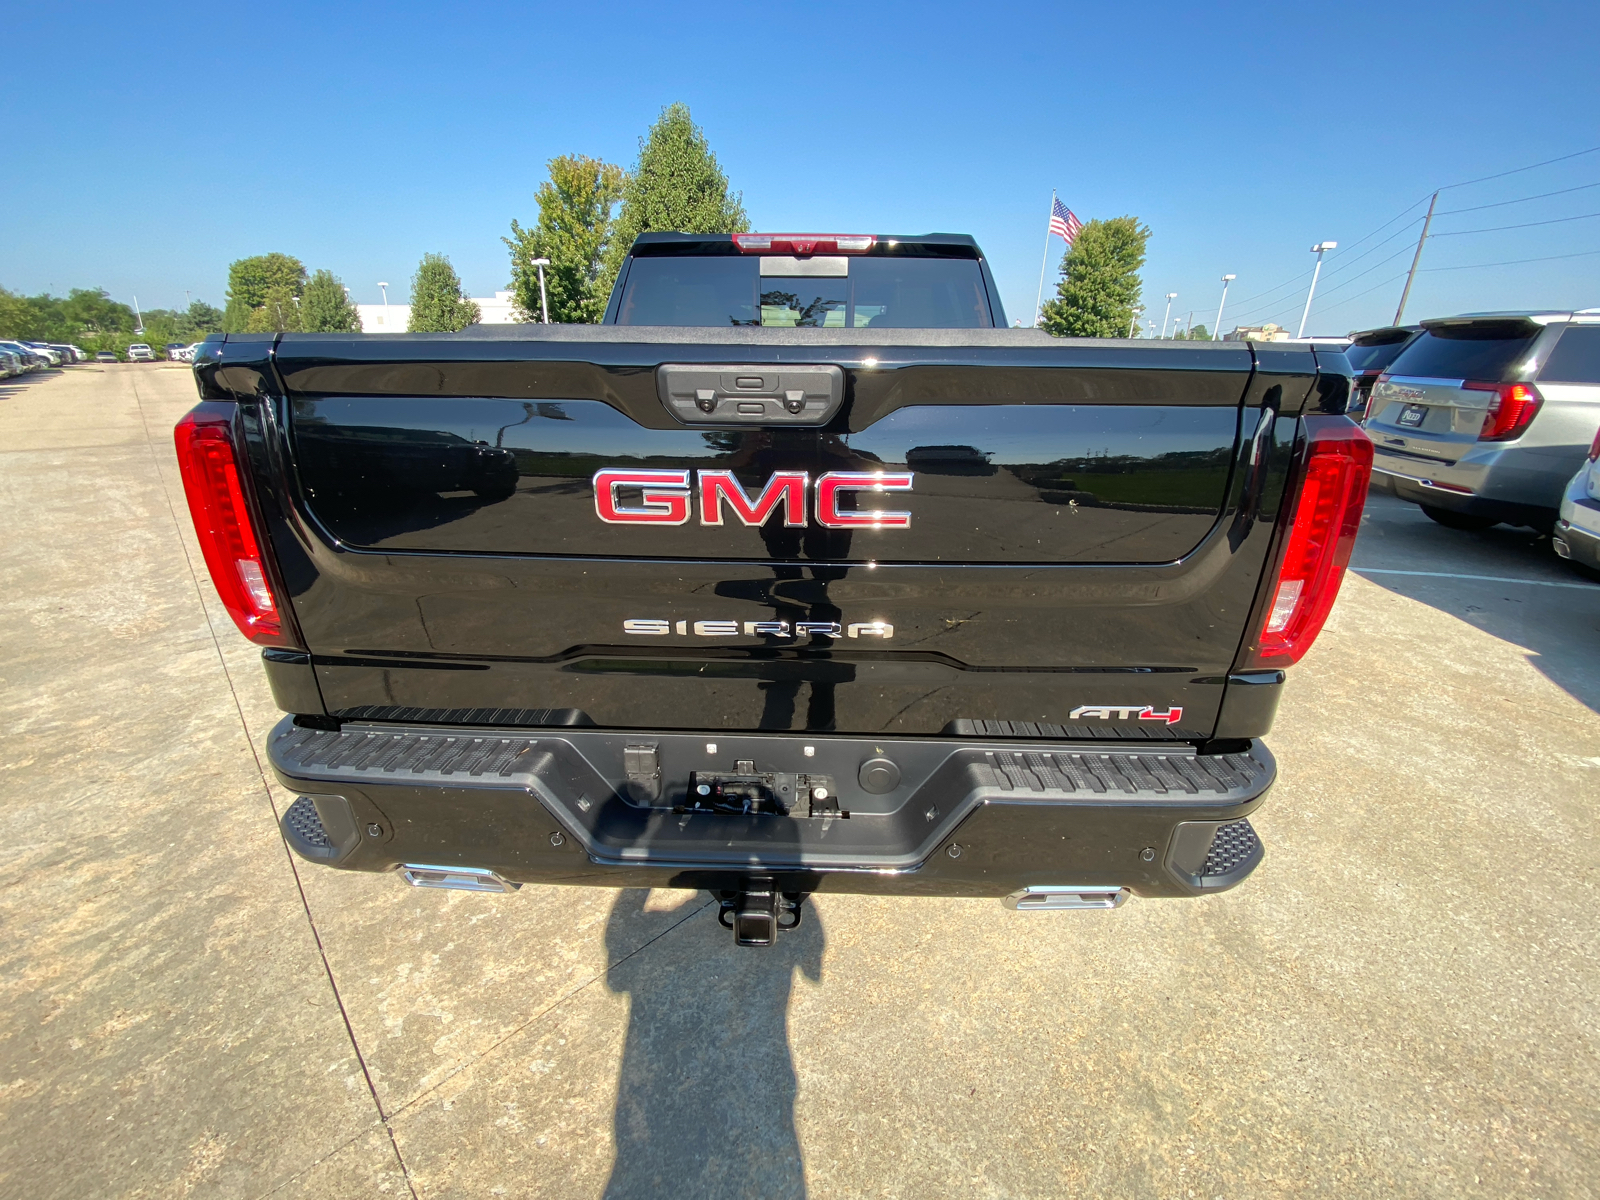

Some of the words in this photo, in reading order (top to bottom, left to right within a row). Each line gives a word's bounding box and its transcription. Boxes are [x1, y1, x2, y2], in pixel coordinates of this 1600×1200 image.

[593, 467, 914, 529] GMC
[623, 619, 894, 639] SIERRA
[1069, 705, 1184, 726] AT4
